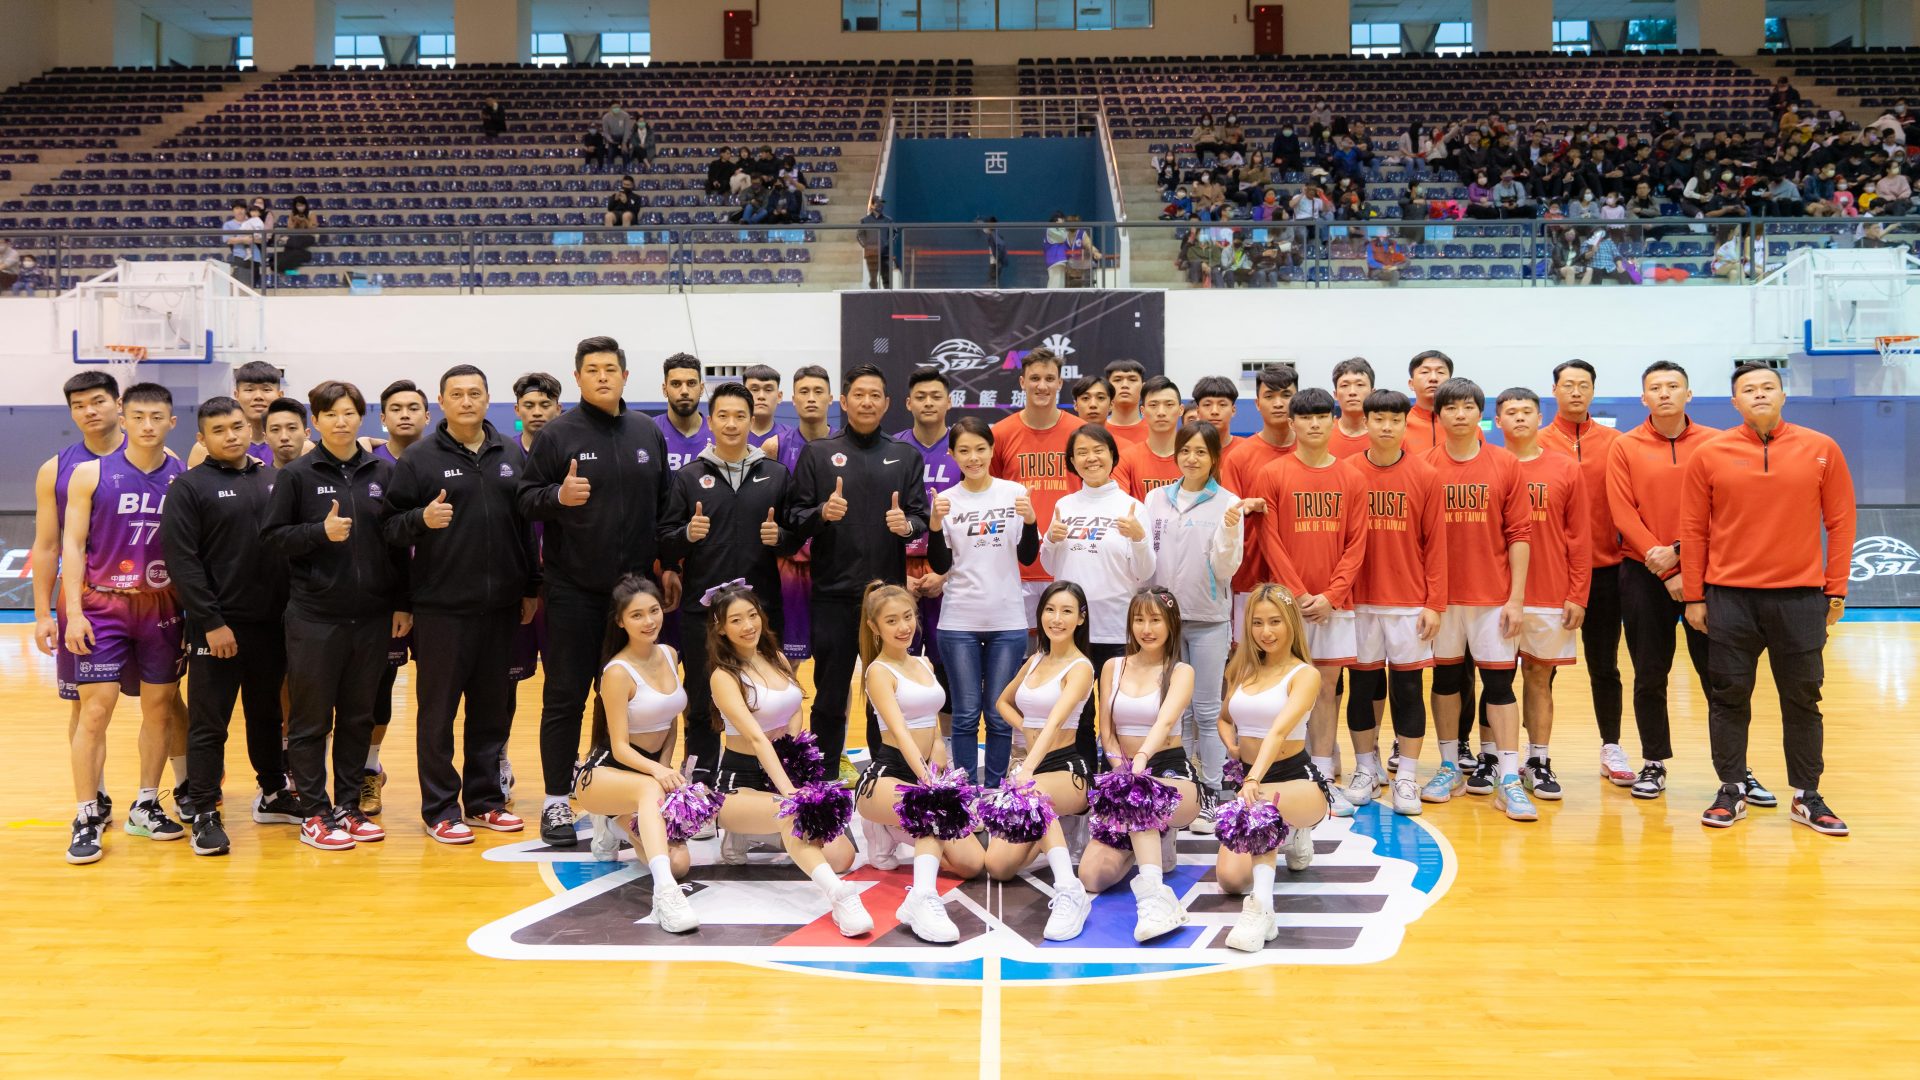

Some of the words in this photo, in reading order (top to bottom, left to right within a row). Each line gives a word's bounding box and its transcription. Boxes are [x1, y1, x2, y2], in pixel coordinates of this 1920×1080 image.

[984, 151, 1008, 174] 西
[580, 453, 598, 461] BLL
[1017, 452, 1066, 478] TRUST
[444, 469, 463, 478] BLL
[923, 463, 950, 482] LL
[218, 490, 236, 498] BLL
[317, 486, 336, 494] BLL
[1443, 484, 1488, 509] RUST
[1293, 492, 1342, 518] TRUST
[1368, 491, 1406, 517] RUST
[952, 511, 979, 524] WE
[983, 507, 1015, 520] ARE
[1061, 516, 1087, 526] WE
[128, 520, 160, 545] 77
[1383, 519, 1407, 531] TAIWAN
